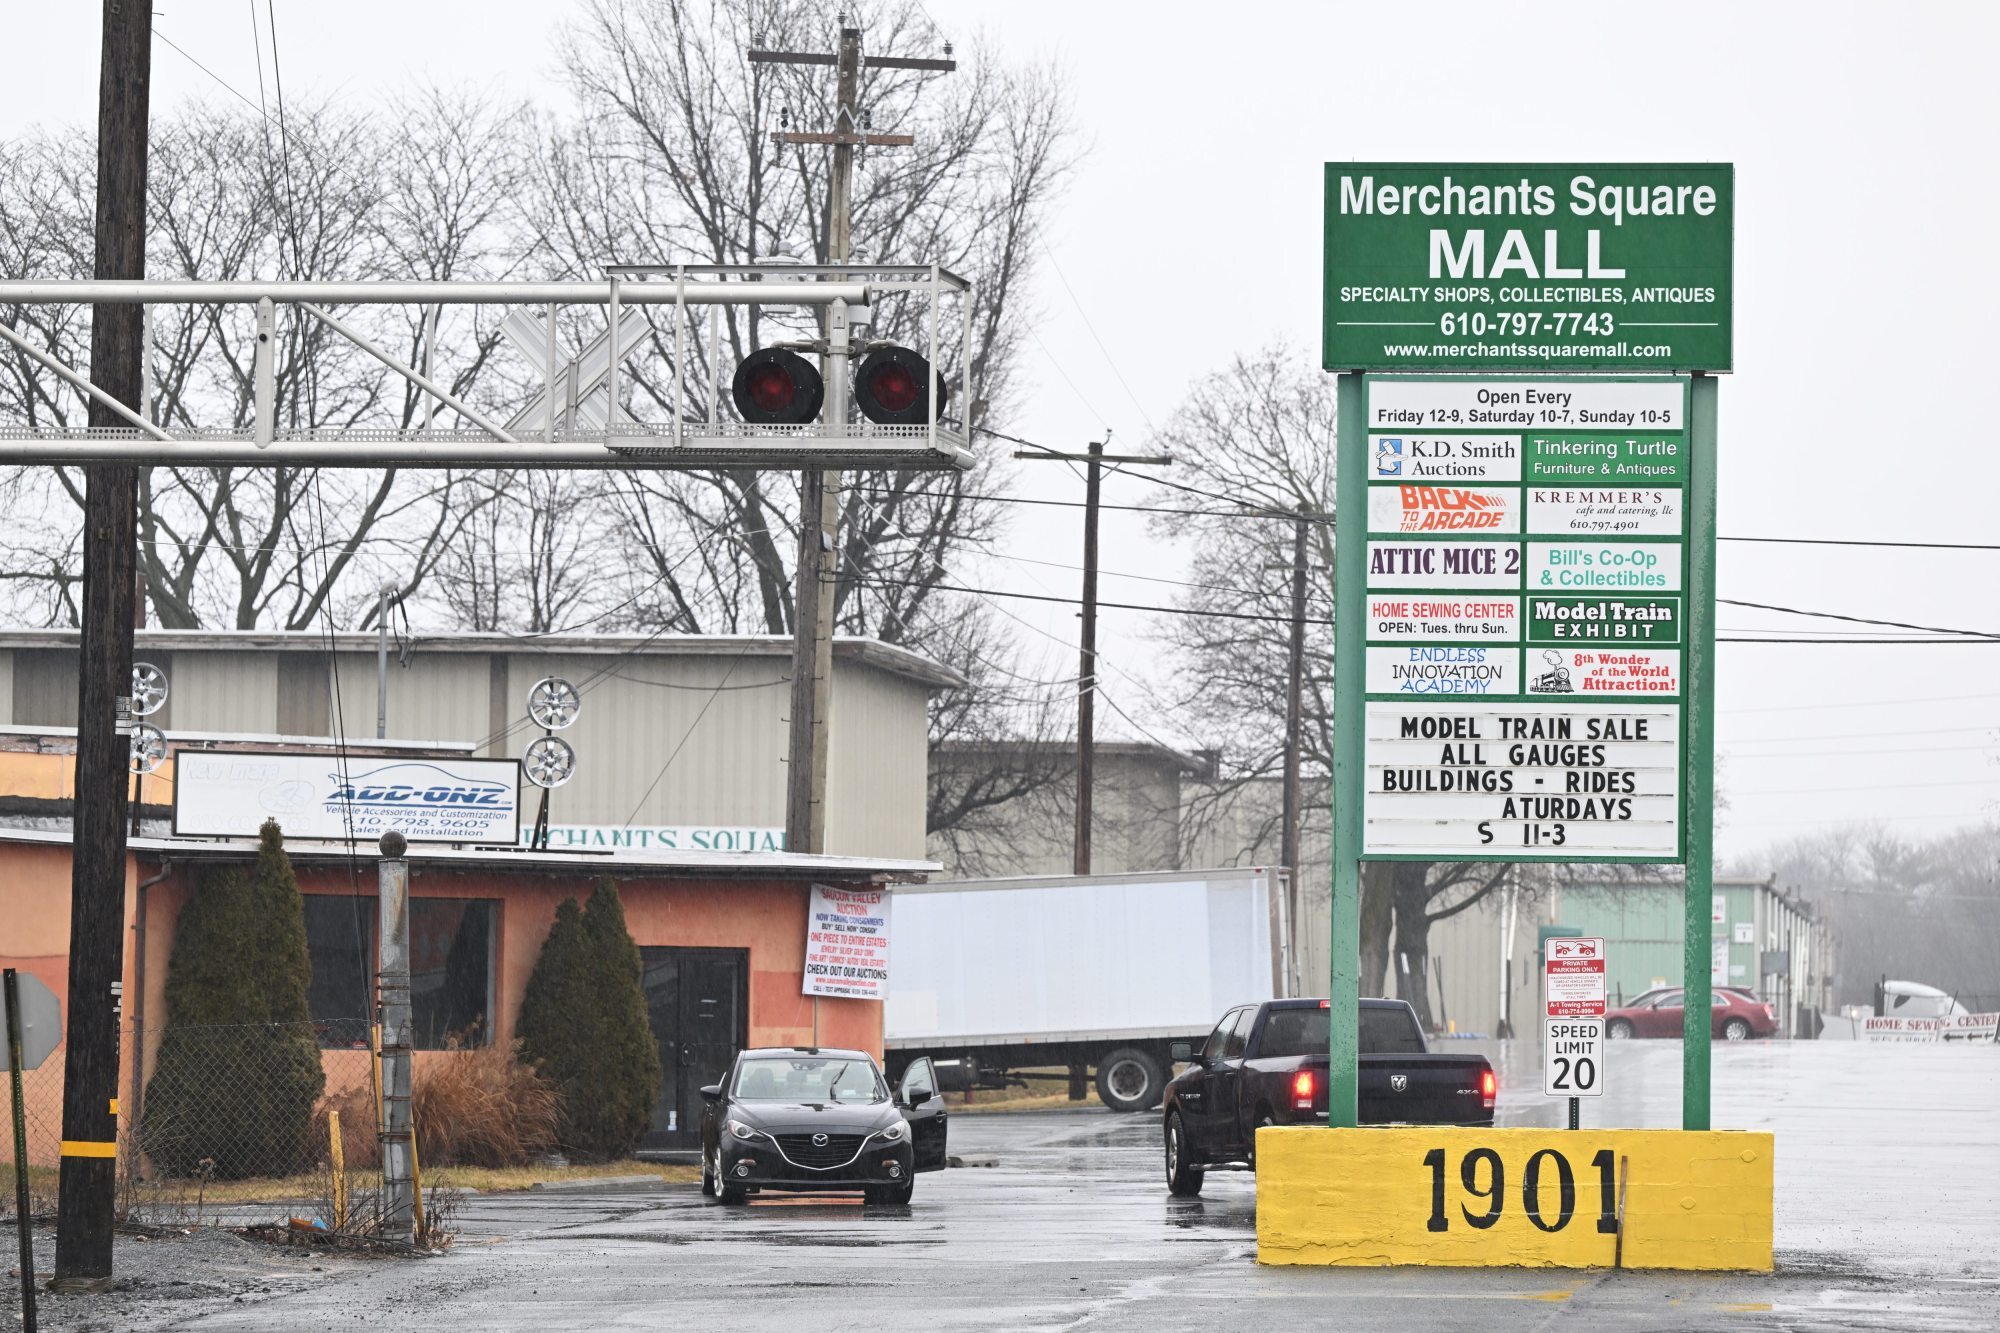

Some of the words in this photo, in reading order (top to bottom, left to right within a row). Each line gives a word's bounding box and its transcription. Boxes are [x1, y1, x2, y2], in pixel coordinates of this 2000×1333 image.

[1340, 175, 1555, 216] Merchants
[1569, 175, 1717, 226] Square
[1429, 229, 1626, 279] MALL
[1340, 287, 1429, 303] SPECIALTY
[1434, 287, 1495, 305] SHOPS,
[1499, 287, 1627, 305] COLLECTIBLES,
[1631, 288, 1715, 304] ANTIQUES
[1440, 312, 1614, 336] 610-797-7743
[1384, 342, 1671, 360] www.merchantssquaremall.com
[1477, 389, 1520, 407] Open
[1526, 389, 1571, 408] Every
[1378, 409, 1424, 425] Friday
[1429, 410, 1464, 425] 12-9,
[1468, 410, 1534, 425] Saturday
[1539, 410, 1574, 425] 10-7,
[1579, 410, 1635, 426] Sunday
[1640, 410, 1671, 423] 10-5
[1411, 441, 1456, 458] K.D.
[1460, 441, 1516, 458] Smith
[1534, 440, 1618, 459] Tinkering
[1625, 440, 1677, 456] Turtle
[1411, 461, 1486, 476] Auctions
[1534, 462, 1595, 475] Furniture
[1601, 464, 1610, 475] &
[1616, 463, 1676, 477] Antiques
[1400, 485, 1489, 510] BACK
[1535, 491, 1663, 505] KREMMER'S
[1403, 511, 1419, 522] TO
[1575, 505, 1595, 516] cafe
[1597, 505, 1615, 516] and
[1618, 506, 1658, 518] catering,
[1662, 506, 1674, 516] llc
[1400, 523, 1418, 532] THE
[1418, 511, 1504, 531] ARCADE
[1570, 519, 1639, 530] 610.797.4901
[1370, 548, 1435, 575] ATTIC
[1443, 548, 1497, 575] MICE
[1504, 548, 1519, 575] 2
[1549, 550, 1593, 566] Bill's
[1599, 550, 1657, 569] Co-Op
[1540, 570, 1553, 586] &
[1559, 570, 1666, 586] Collectibles
[1372, 602, 1409, 618] HOME
[1412, 603, 1461, 619] SEWING
[1464, 603, 1515, 619] CENTER
[1535, 601, 1607, 621] Model
[1609, 602, 1673, 622] Train
[1378, 622, 1417, 634] OPEN:
[1420, 622, 1451, 634] Tues.
[1454, 622, 1478, 634] thru
[1481, 622, 1508, 634] Sun.
[1554, 623, 1654, 638] EXHIBIT
[1409, 647, 1487, 663] ENDLESS
[1573, 653, 1594, 667] 8th
[1597, 654, 1651, 665] Wonder
[1392, 664, 1503, 680] INNOVATION
[1591, 666, 1604, 677] of
[1608, 667, 1627, 677] the
[1627, 666, 1670, 678] World
[1400, 679, 1491, 694] ACADEMY
[1581, 677, 1676, 692] Attraction!
[1401, 716, 1481, 739] MODEL
[1498, 717, 1571, 740] TRAIN
[1587, 718, 1648, 740] SALE
[1440, 743, 1487, 765] ALL
[1509, 744, 1605, 766] GAUGES
[1383, 769, 1513, 792] BUILDINGS
[1566, 771, 1635, 793] RIDES
[326, 805, 360, 815] Vehicle
[362, 807, 417, 817] Accessories
[419, 809, 437, 818] and
[440, 810, 508, 820] Customization
[1502, 797, 1632, 820] ATURDAYS
[343, 817, 490, 829] 610.798.9605
[349, 825, 381, 834] Sales
[413, 827, 484, 837] Installation
[1477, 822, 1494, 844] S
[816, 913, 830, 922] NOW
[836, 903, 868, 916] AUCTION
[810, 932, 822, 942] ONE
[824, 933, 839, 944] PIECE
[841, 934, 848, 944] TO
[866, 937, 887, 948] ESTATES
[807, 964, 829, 975] CHECK
[829, 965, 842, 977] OUT
[844, 966, 856, 978] OUR
[856, 967, 887, 980] AUCTIONS
[1866, 1019, 1902, 1030] HOME
[1957, 1015, 1997, 1027] CENTER
[1551, 1025, 1598, 1038] SPEED
[1555, 1042, 1594, 1054] LIMIT
[1552, 1057, 1596, 1090] 20
[1423, 1147, 1619, 1233] 1901
